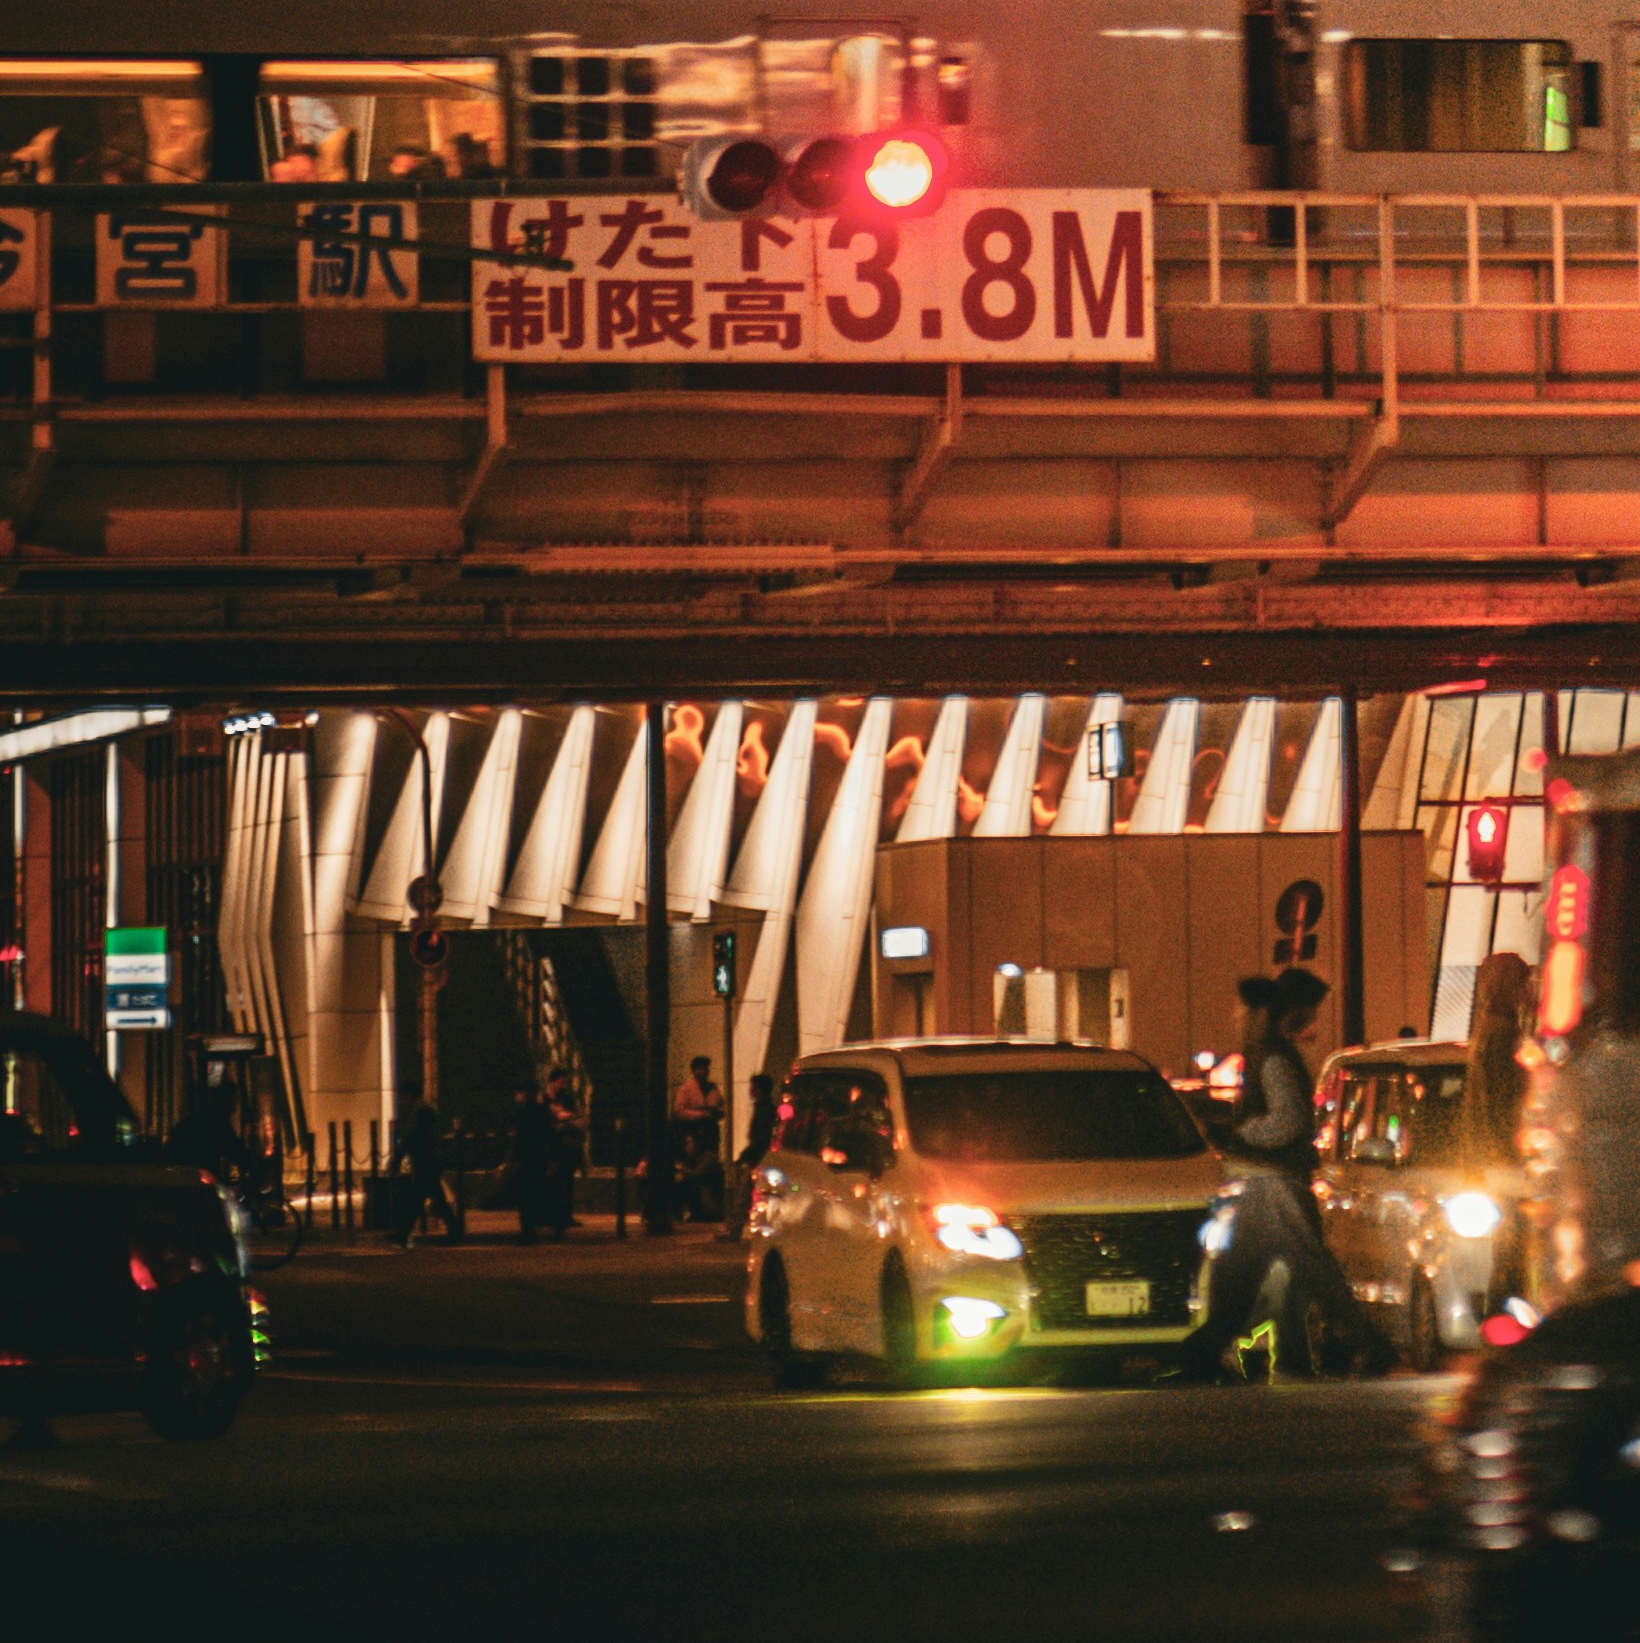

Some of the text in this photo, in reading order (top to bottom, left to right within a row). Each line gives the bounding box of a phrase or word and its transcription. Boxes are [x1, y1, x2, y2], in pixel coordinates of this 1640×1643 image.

[484, 277, 805, 351] 制限高
[825, 207, 1145, 343] 3.8M
